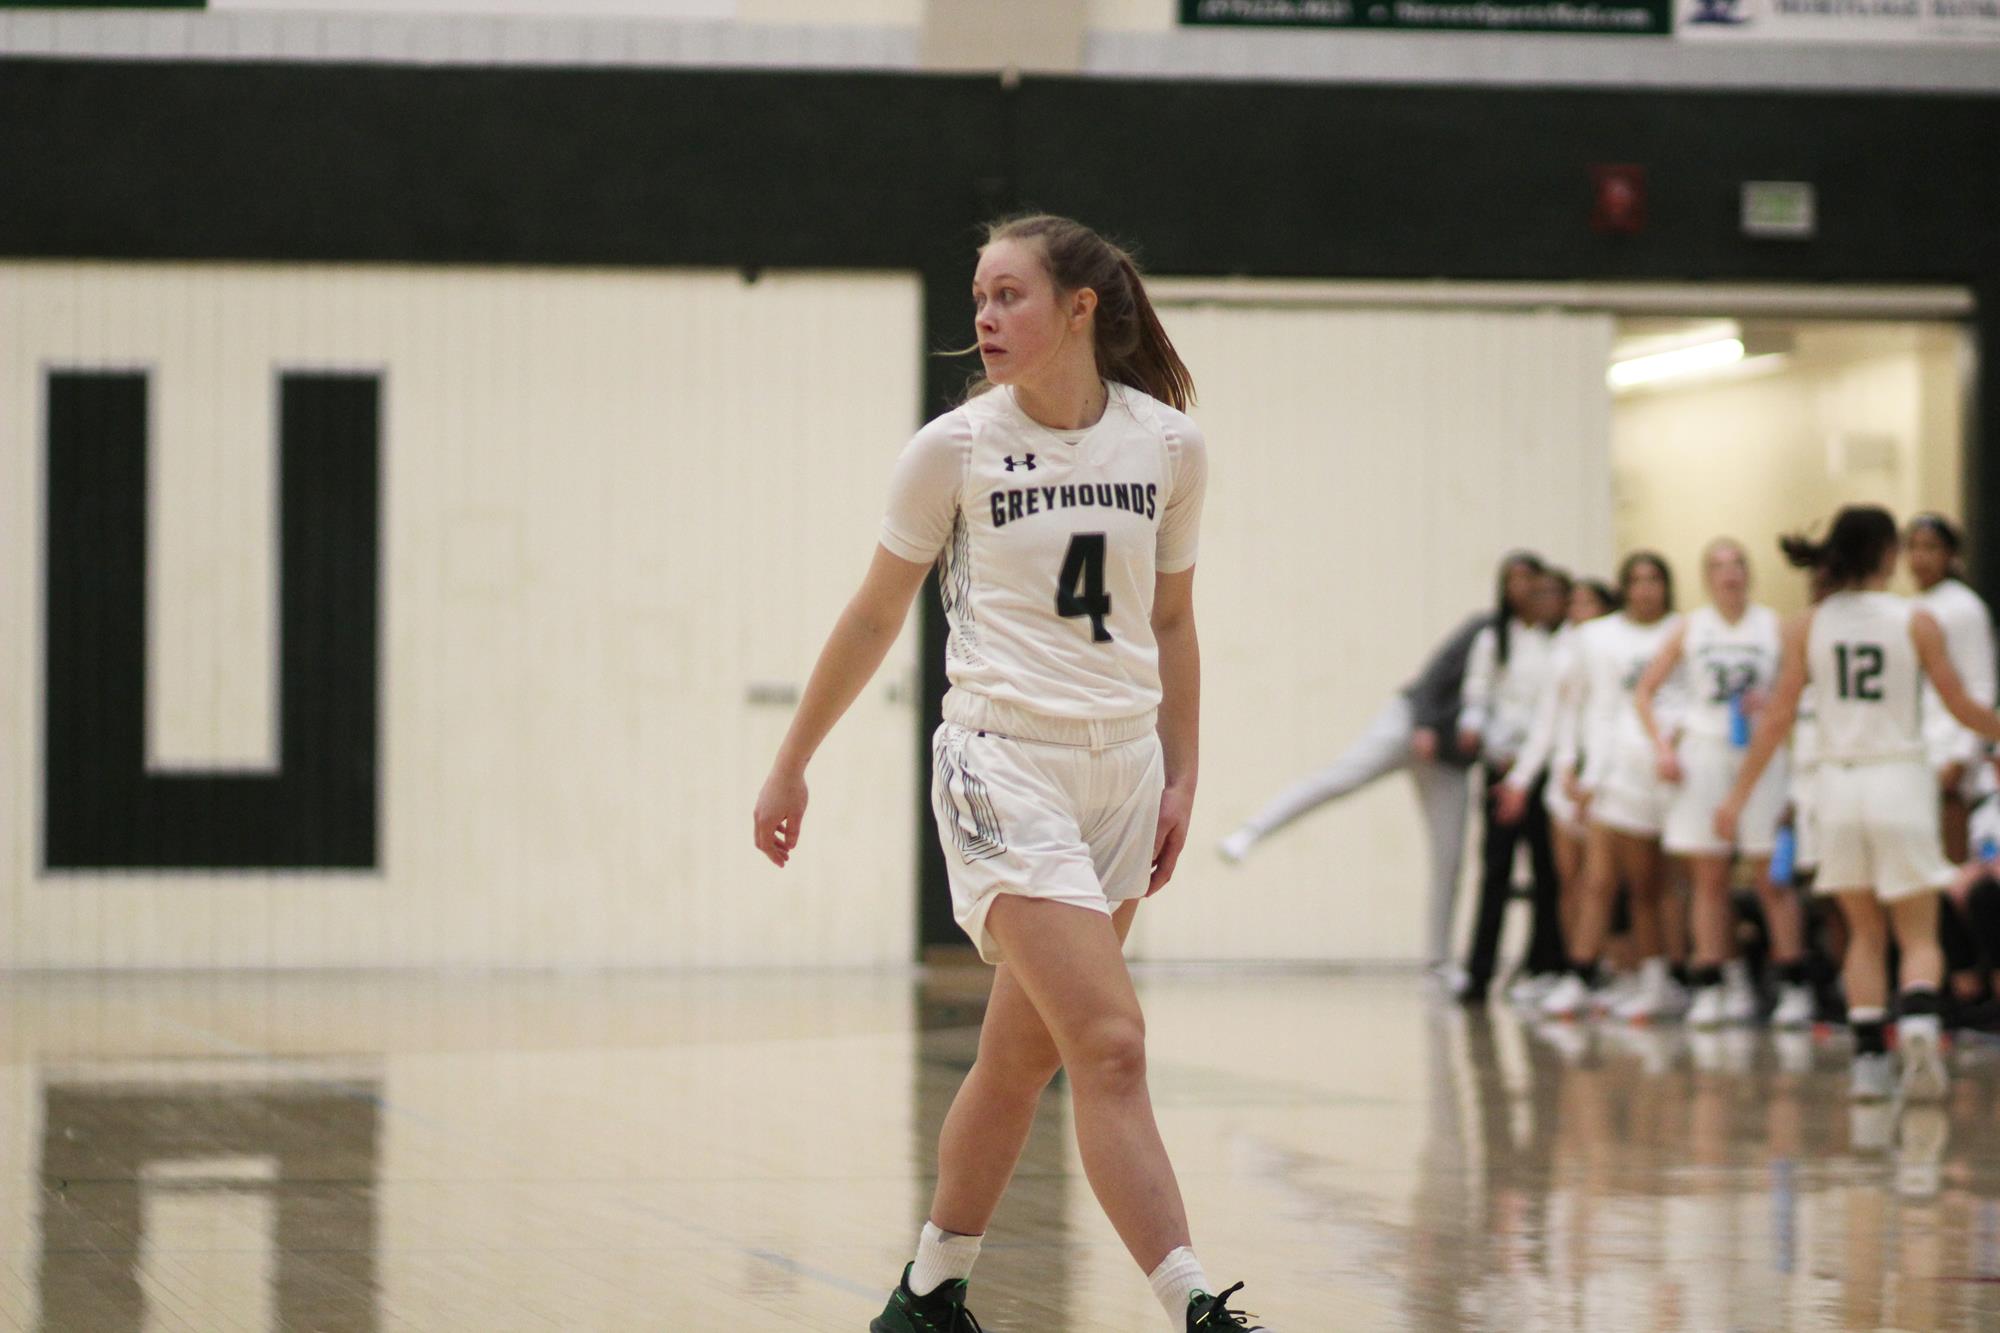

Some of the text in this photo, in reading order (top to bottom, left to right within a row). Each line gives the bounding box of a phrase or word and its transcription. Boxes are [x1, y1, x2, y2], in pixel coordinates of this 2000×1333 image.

[990, 482, 1157, 528] GREYHOUNDS
[46, 369, 382, 870] U
[1055, 531, 1114, 643] 4
[1833, 641, 1885, 702] 12
